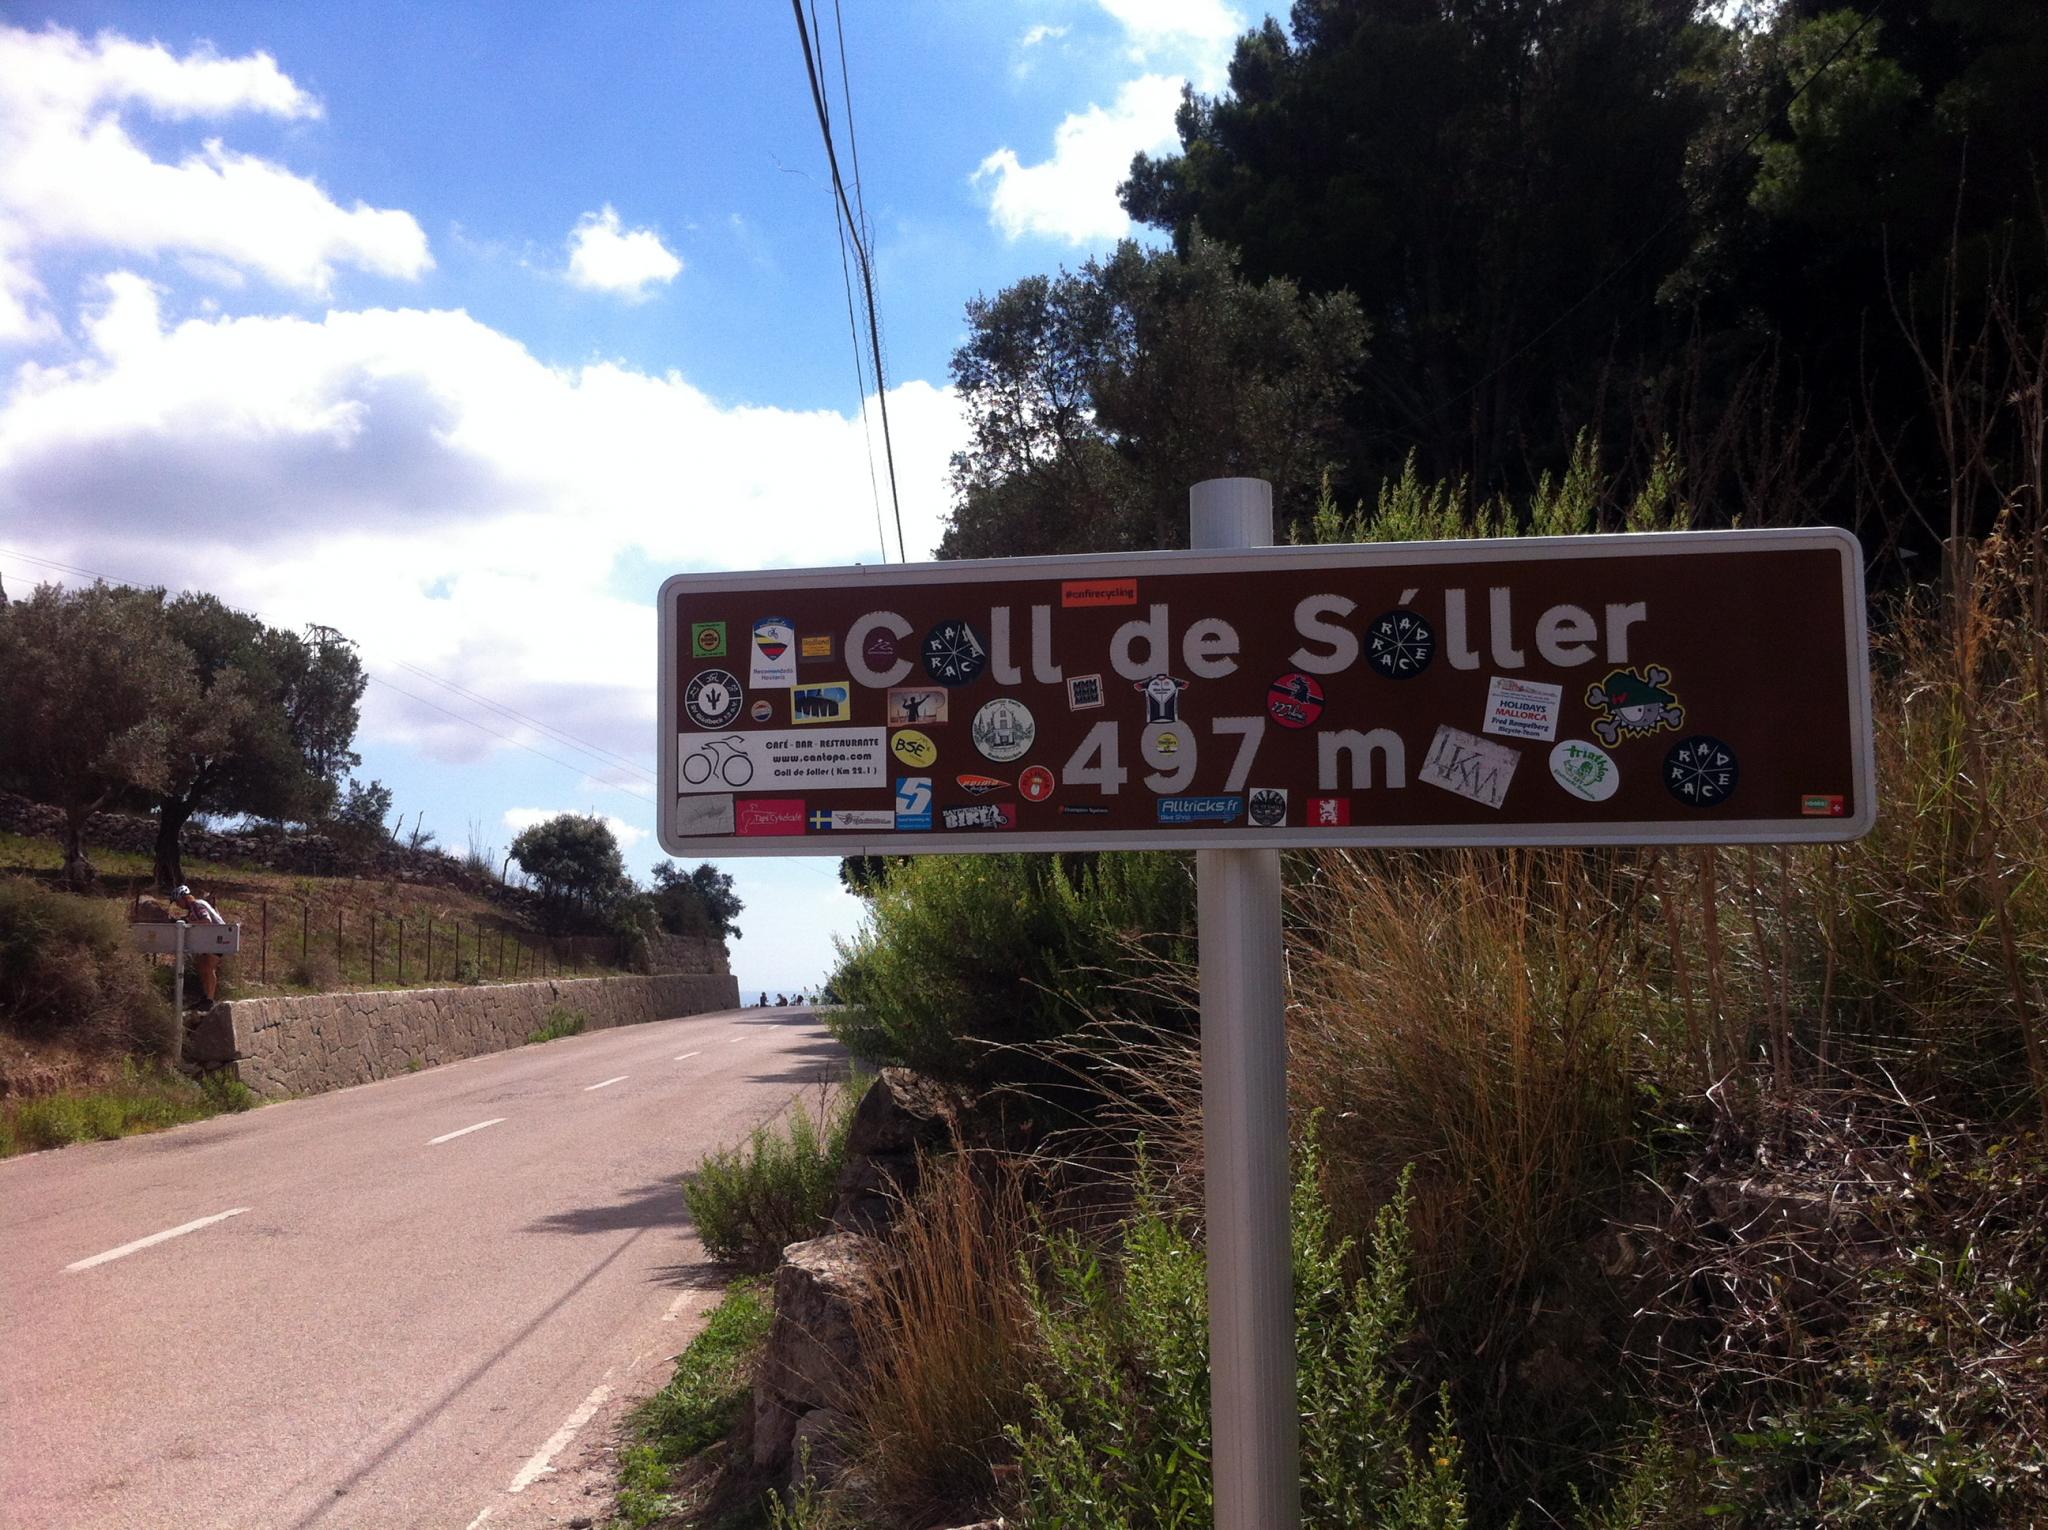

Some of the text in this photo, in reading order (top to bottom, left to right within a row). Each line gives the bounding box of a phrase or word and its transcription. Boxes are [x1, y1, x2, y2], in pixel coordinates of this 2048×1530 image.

[845, 585, 1647, 689] Cll de Sller
[1499, 700, 1547, 713] HOLIDAYS
[1495, 708, 1548, 721] MALLORCA
[765, 739, 788, 749] CAFÉ
[795, 740, 813, 748] BAR
[819, 738, 879, 748] RESTAURANTE
[895, 738, 926, 757] BSE
[773, 752, 872, 763] www.cantopa.com
[1062, 716, 1406, 795] 497 m
[793, 768, 804, 776] de
[806, 767, 829, 776] Soller
[1161, 799, 1239, 812] Alltricks.fr
